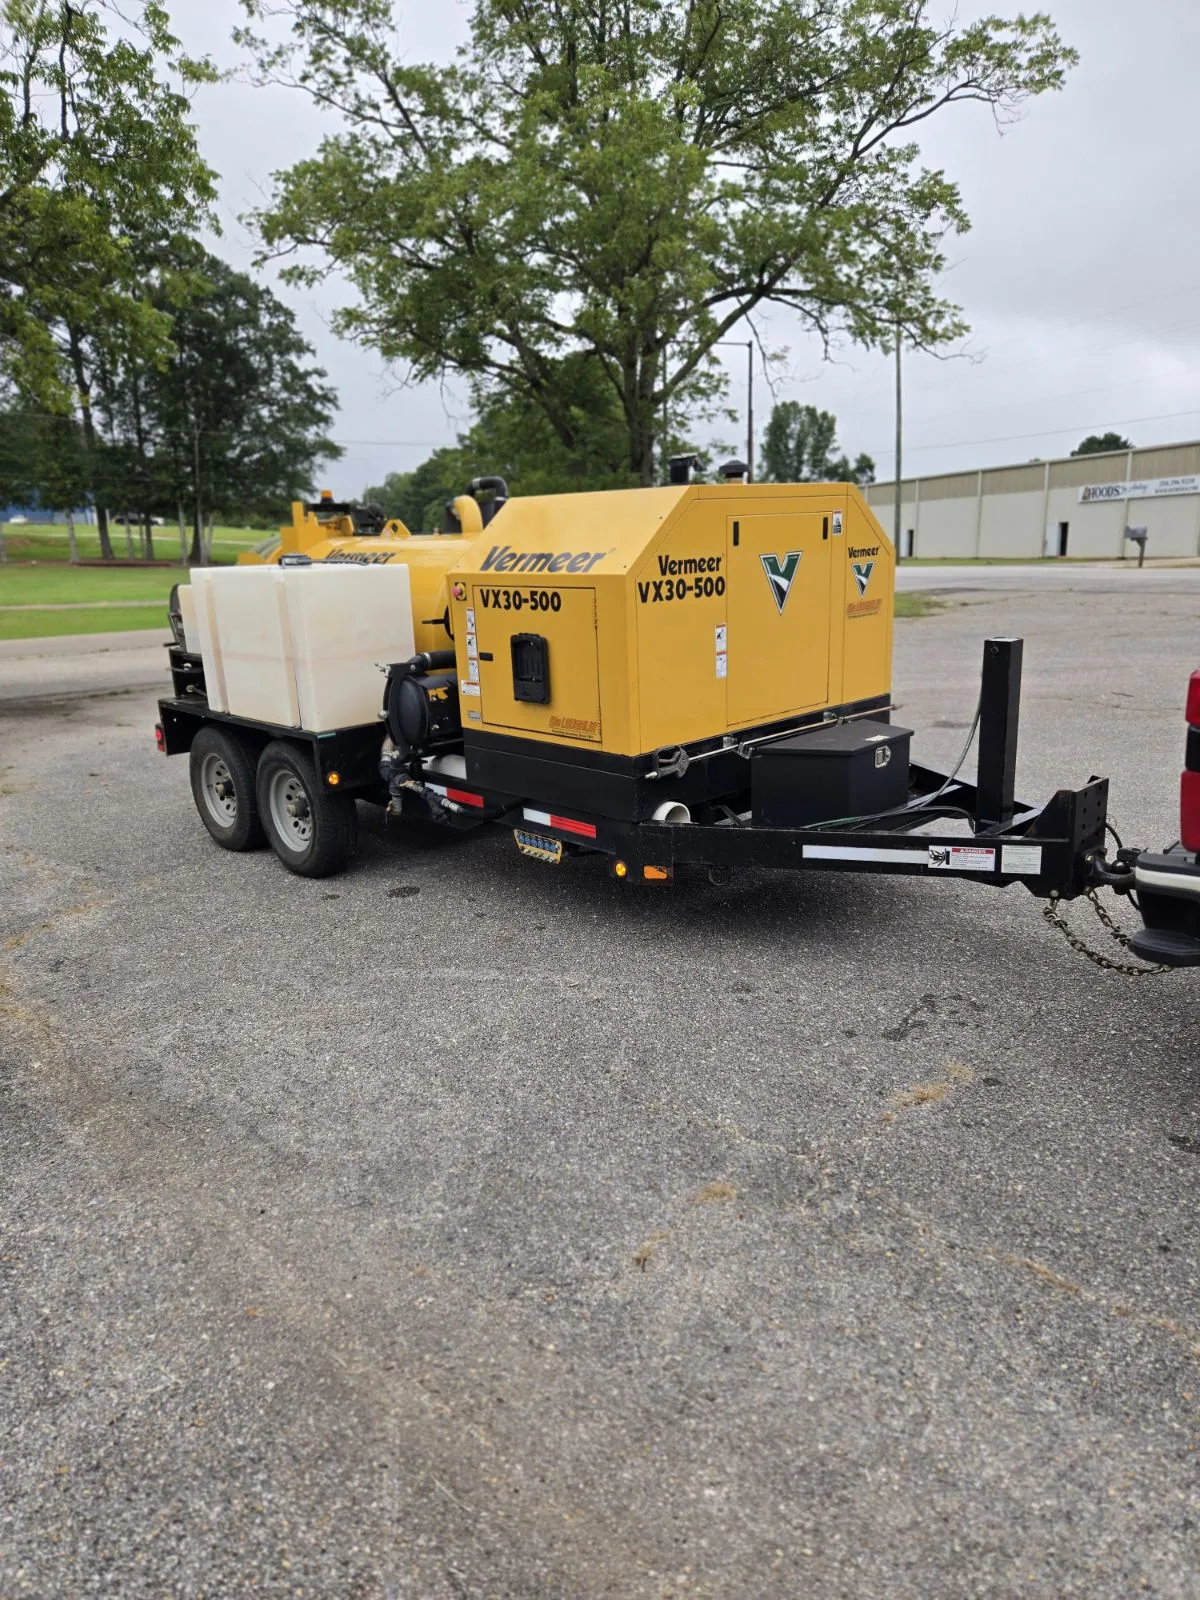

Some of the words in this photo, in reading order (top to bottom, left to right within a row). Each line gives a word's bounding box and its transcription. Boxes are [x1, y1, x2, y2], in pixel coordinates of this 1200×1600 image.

[326, 549, 397, 564] Vermeer
[479, 545, 606, 573] Vermeer
[848, 546, 879, 558] Vermeer
[658, 555, 722, 576] Vermeer
[480, 588, 562, 612] VX30-500
[638, 576, 726, 603] VX30-500
